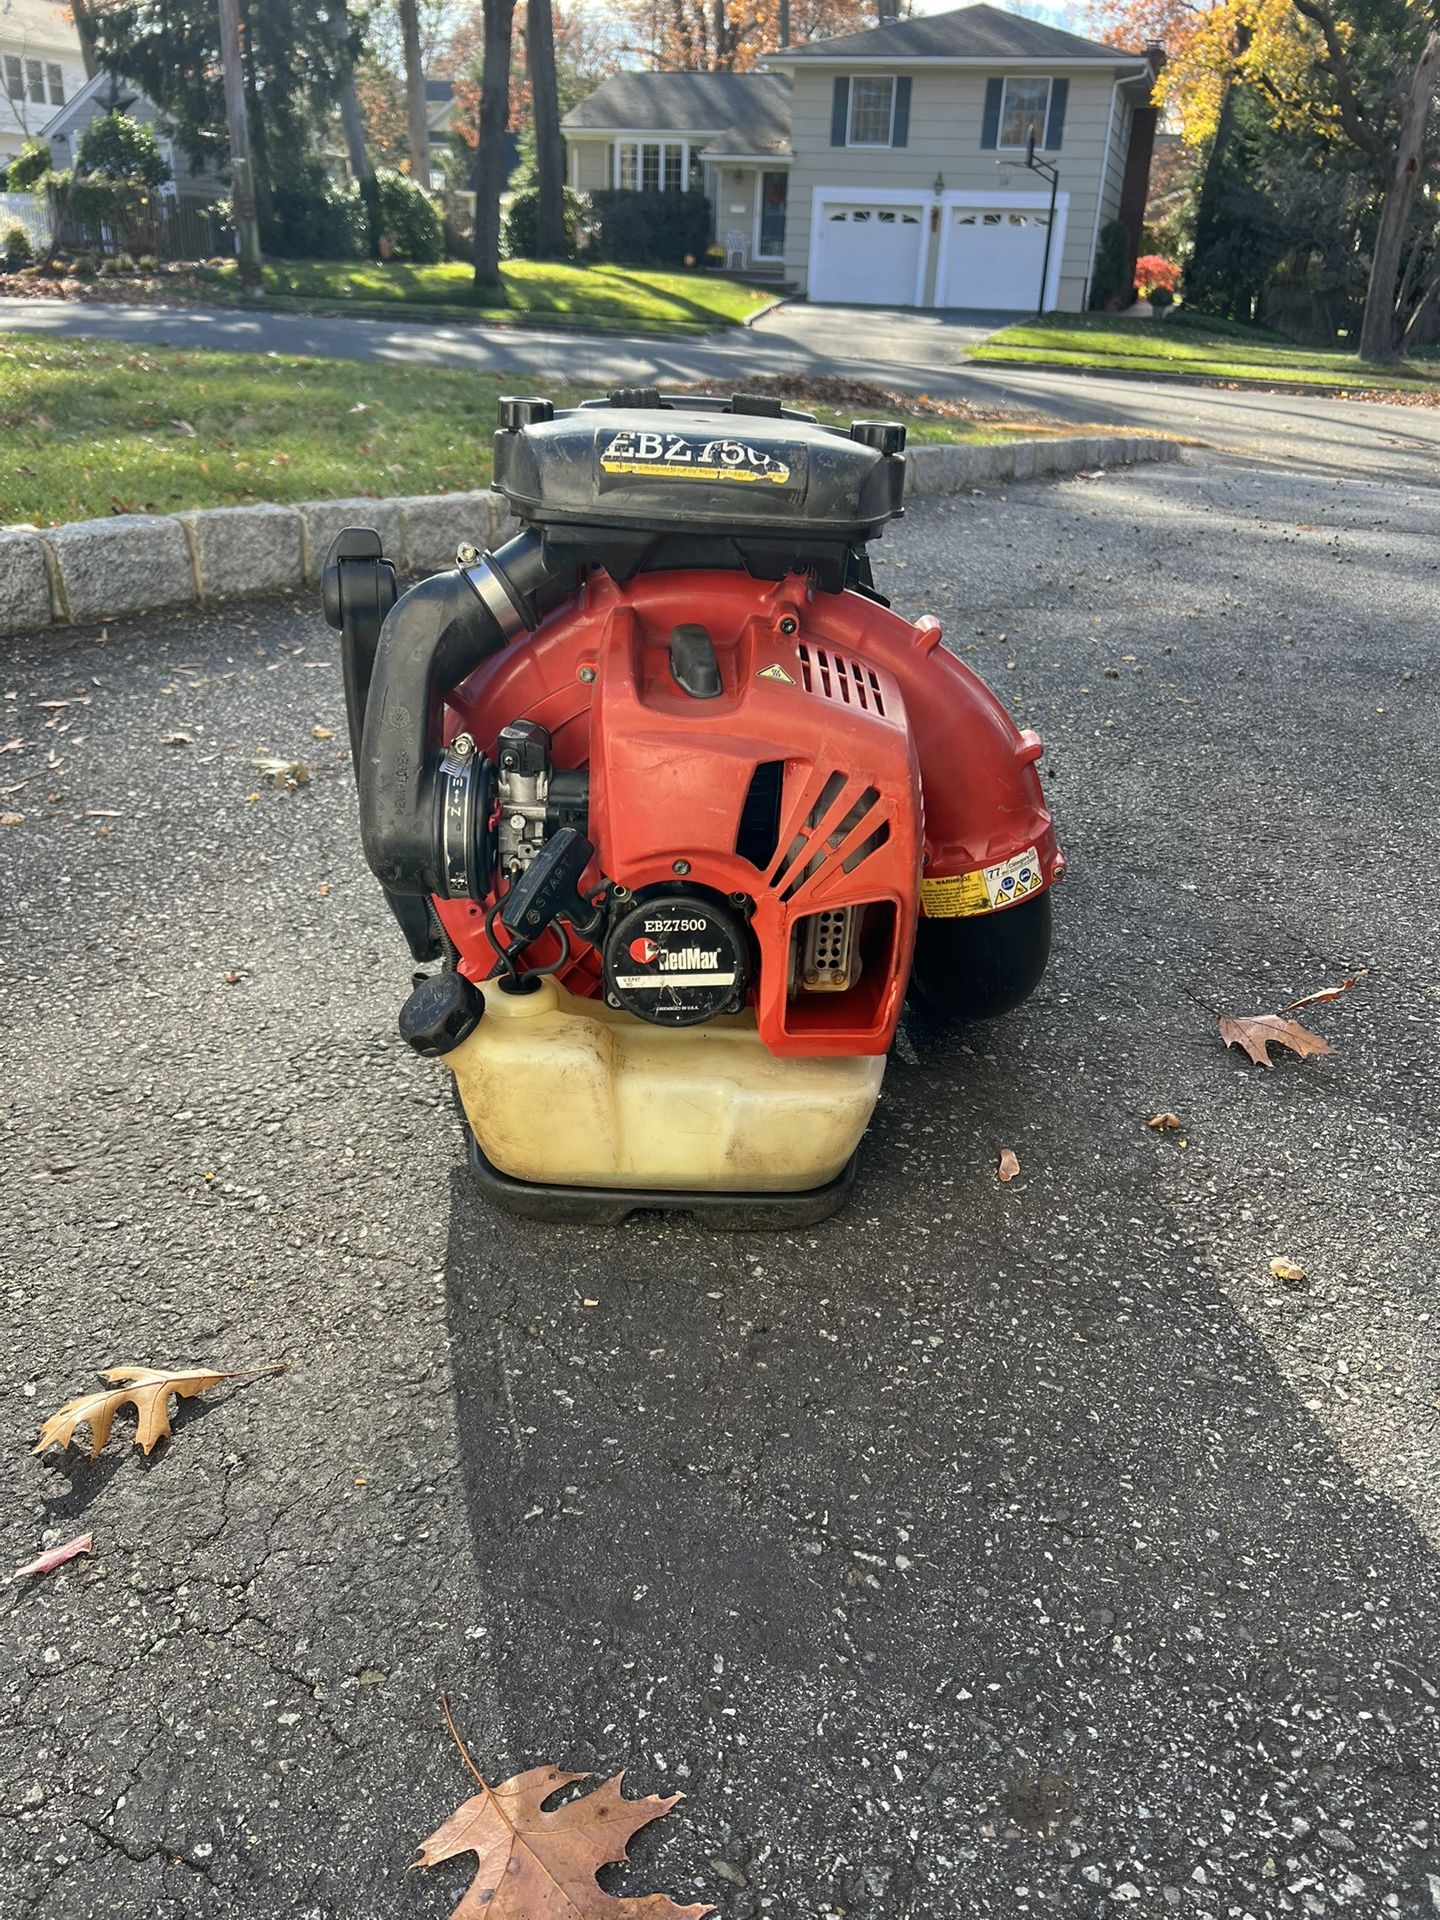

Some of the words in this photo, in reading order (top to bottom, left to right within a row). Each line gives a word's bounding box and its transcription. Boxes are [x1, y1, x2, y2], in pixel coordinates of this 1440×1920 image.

[987, 867, 1001, 879] 77
[535, 854, 571, 908] START
[644, 919, 707, 933] EBZ7500
